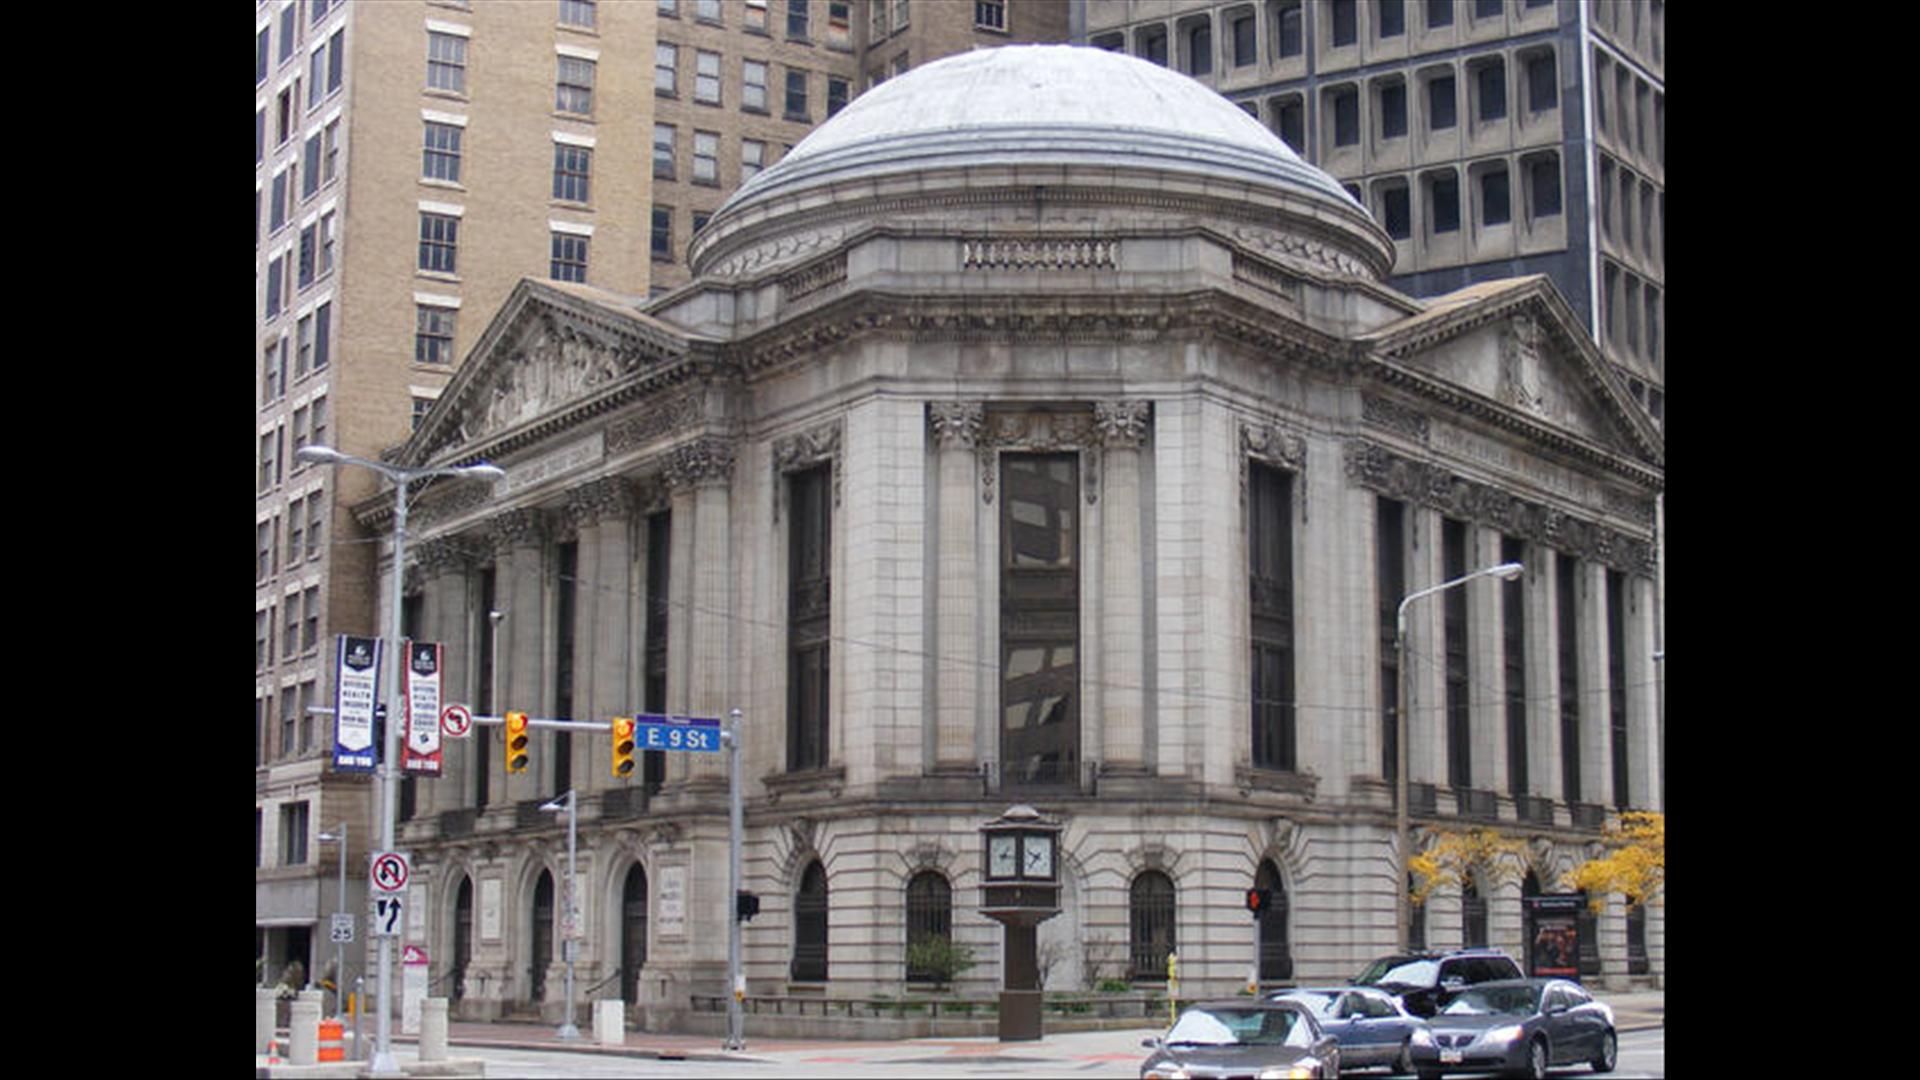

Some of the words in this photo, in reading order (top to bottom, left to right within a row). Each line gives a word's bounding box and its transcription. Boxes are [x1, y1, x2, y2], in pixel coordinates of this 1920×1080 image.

[670, 728, 681, 747] 9
[686, 729, 708, 749] St
[332, 928, 352, 941] 25
